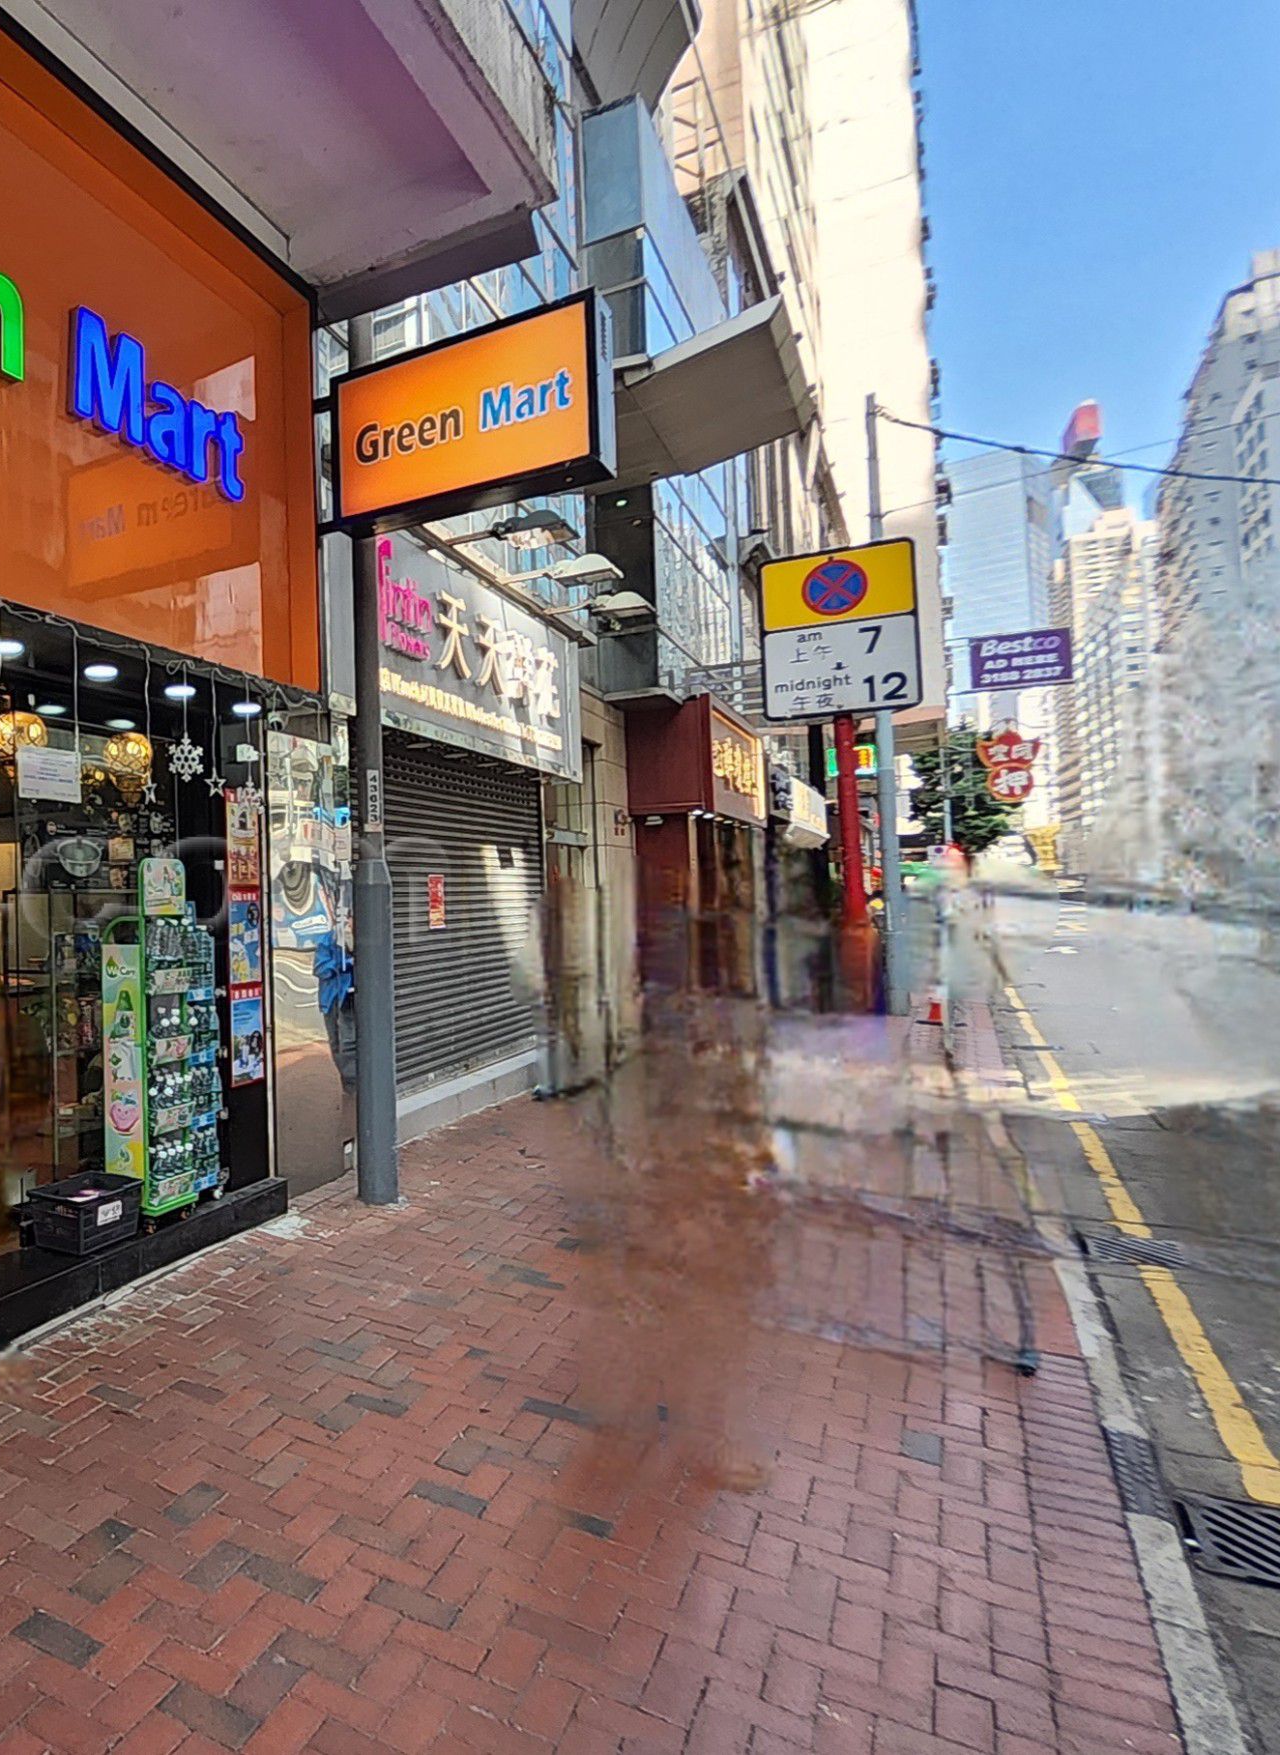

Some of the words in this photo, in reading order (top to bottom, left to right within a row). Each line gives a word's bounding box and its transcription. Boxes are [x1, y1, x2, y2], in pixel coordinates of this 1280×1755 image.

[72, 305, 245, 502] Mart
[355, 405, 463, 465] Green
[479, 367, 573, 433] Mart
[789, 644, 833, 664] 上午
[796, 630, 823, 644] am
[857, 624, 883, 654] 7
[979, 635, 1062, 657] Bestco
[774, 673, 853, 694] midnight
[862, 671, 909, 703] 12
[792, 692, 835, 711] 午夜
